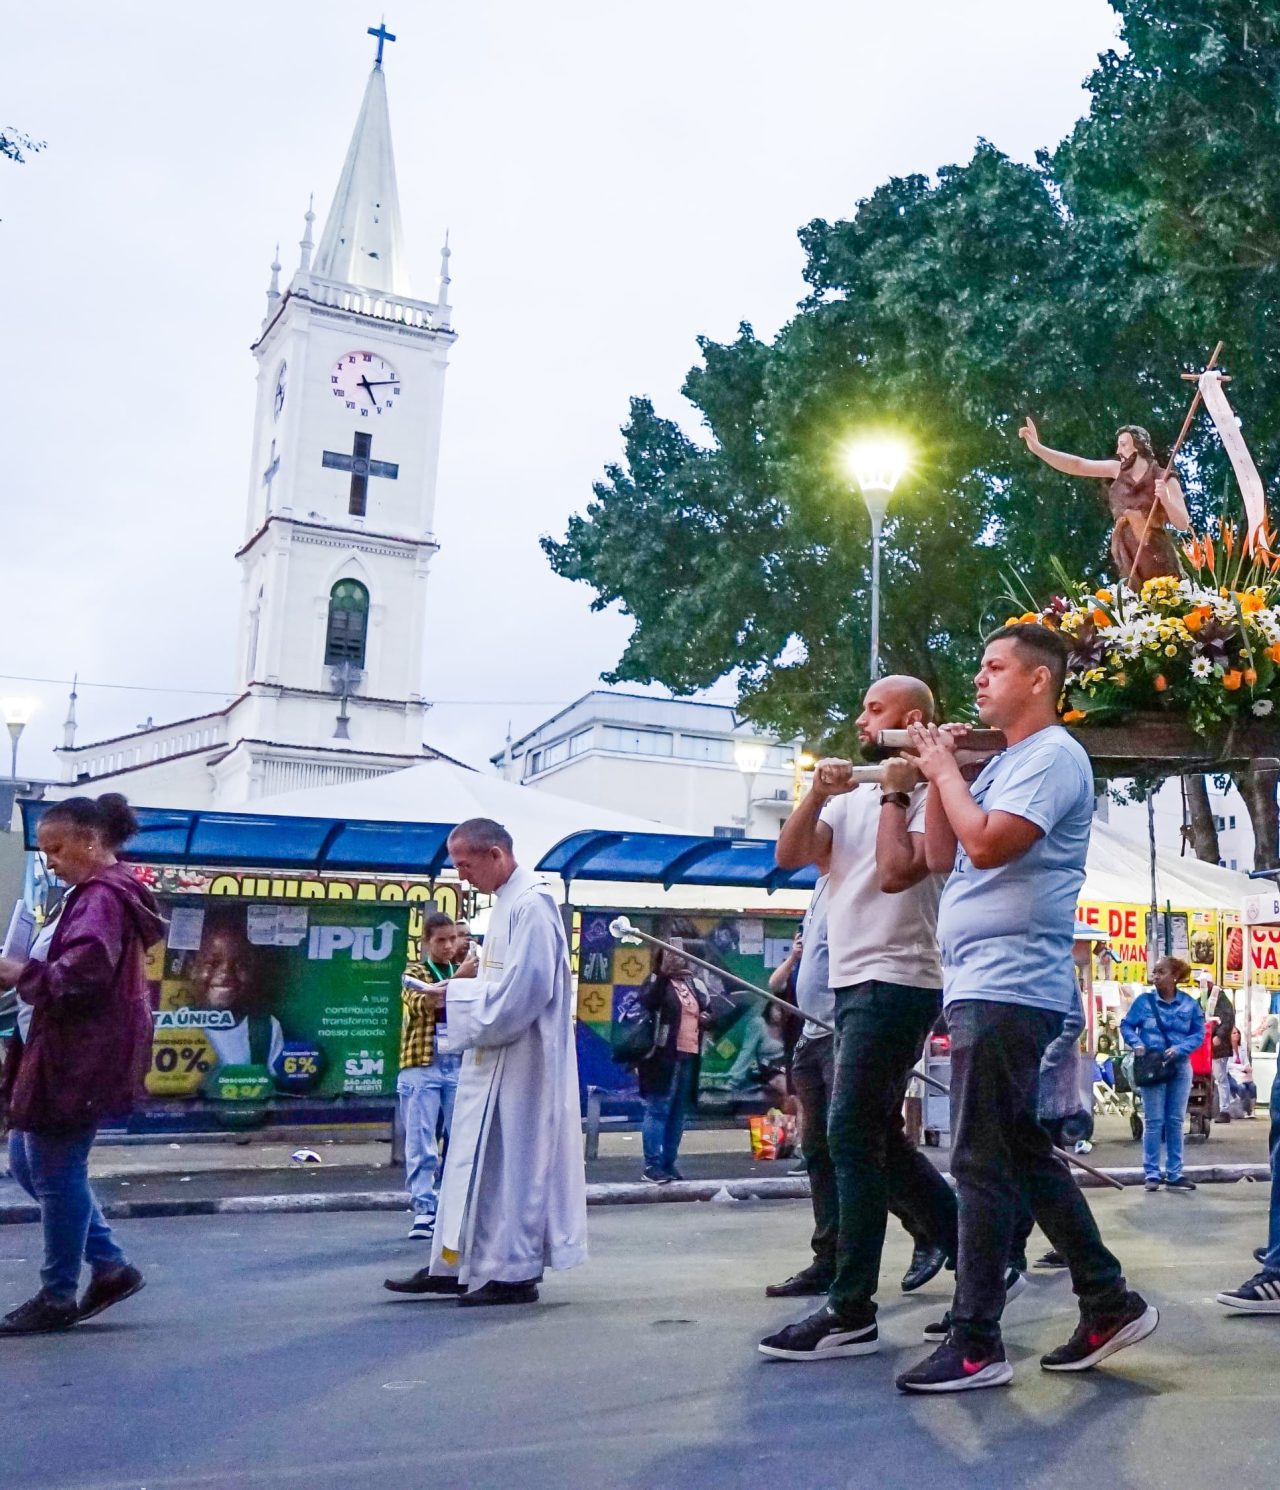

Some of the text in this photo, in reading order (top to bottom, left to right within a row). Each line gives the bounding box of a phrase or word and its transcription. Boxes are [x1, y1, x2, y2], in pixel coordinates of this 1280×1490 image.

[1109, 909, 1136, 938] DE
[308, 920, 399, 960] IPTU
[177, 1008, 232, 1025] ÚNICA
[325, 1006, 389, 1016] contribuição
[322, 1017, 378, 1025] transforma
[318, 1029, 348, 1037] nossa
[283, 1057, 317, 1074] 6%
[345, 1058, 384, 1076] SJM
[218, 1076, 269, 1084] Desconto de
